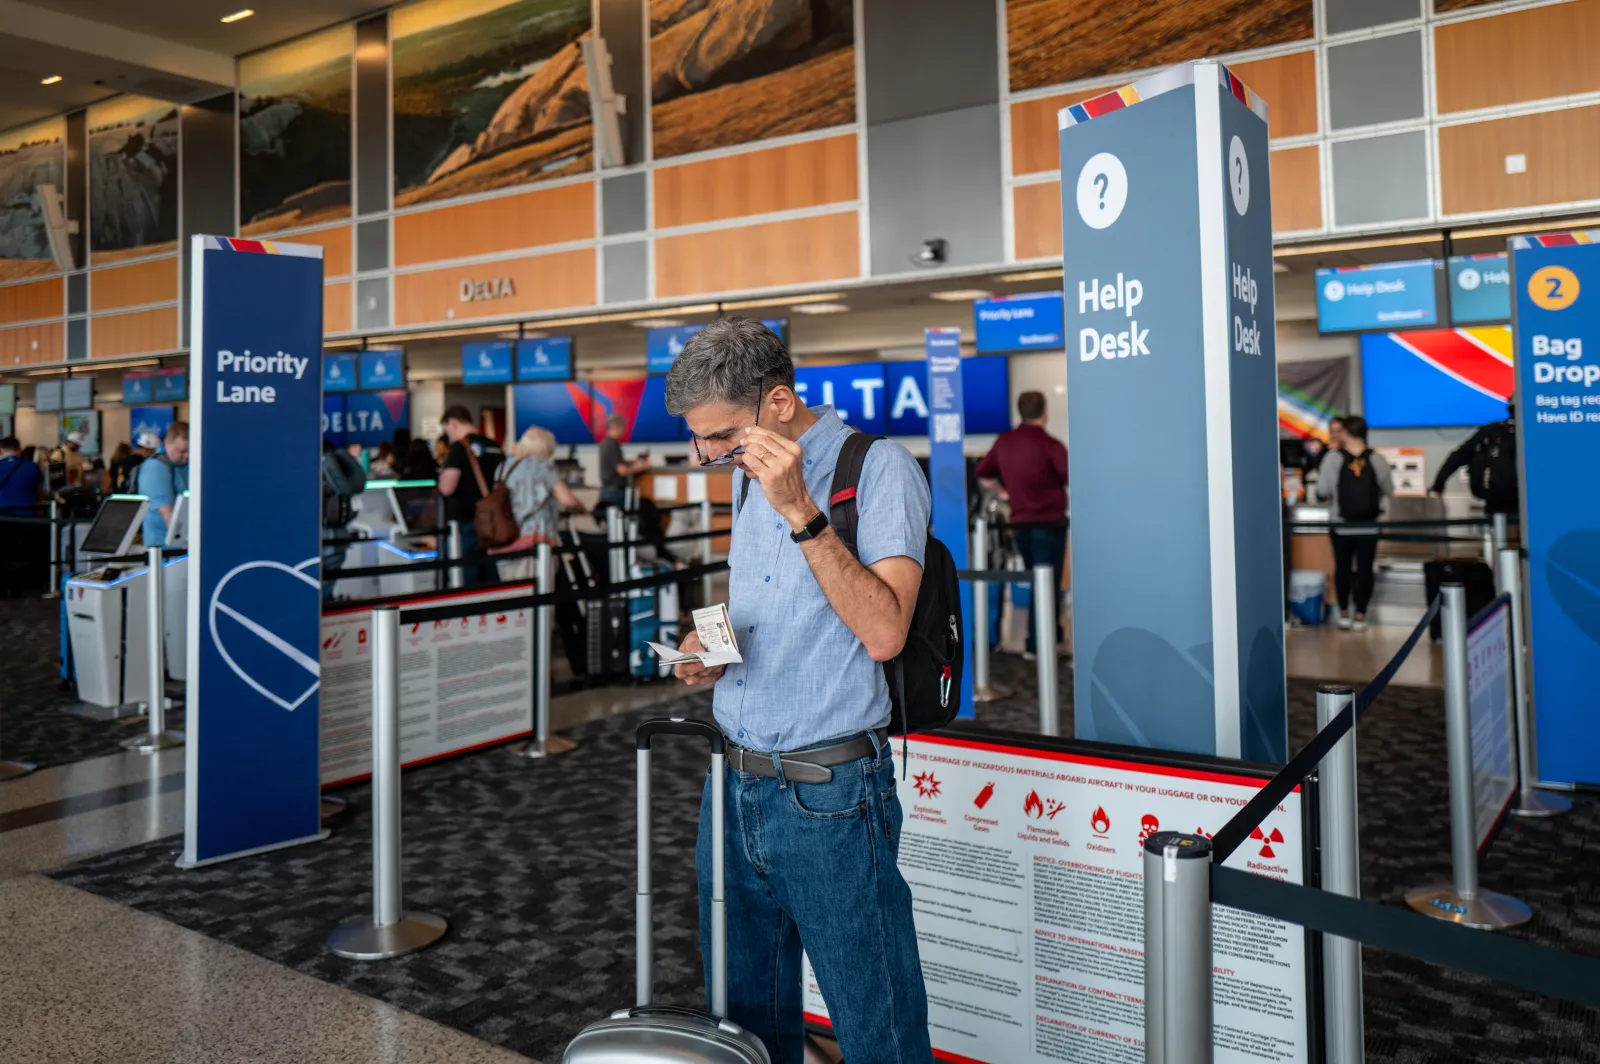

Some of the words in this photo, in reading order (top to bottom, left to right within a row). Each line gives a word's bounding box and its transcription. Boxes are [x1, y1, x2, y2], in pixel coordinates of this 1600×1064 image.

[460, 277, 514, 302] DELTA
[1078, 272, 1144, 317] Help
[1232, 262, 1258, 315] Help
[1545, 277, 1564, 299] 2
[1079, 320, 1150, 362] Desk
[1234, 315, 1261, 356] Desk
[1532, 334, 1582, 361] Bag
[217, 350, 309, 379] Priority
[1534, 361, 1600, 388] Drop
[217, 380, 276, 403] Lane
[1536, 394, 1559, 408] Bag
[1561, 394, 1580, 408] tag
[1537, 412, 1568, 424] Have
[1570, 411, 1584, 423] ID
[916, 752, 927, 760] THE
[929, 754, 961, 765] CARRIAGE
[962, 759, 971, 767] OF
[972, 761, 1015, 773] HAZARDOUS
[1016, 767, 1054, 779] MATERIALS
[1056, 773, 1086, 783] ABOARD
[1088, 777, 1122, 789] AIRCRAFT
[1125, 782, 1133, 790] IN
[1135, 784, 1156, 794] YOUR
[1158, 787, 1195, 799] LUGGAGE
[1196, 793, 1208, 801] OR
[1210, 795, 1221, 803] ON
[913, 804, 942, 816] Explosives
[920, 815, 947, 825] Fireworks
[963, 814, 999, 827] Compressed
[973, 824, 990, 833] Gases
[1026, 824, 1059, 837] Flammable
[1017, 832, 1038, 843] Liquids
[1039, 835, 1051, 844] and
[1051, 837, 1070, 847] Solids
[1086, 842, 1116, 854] Oxidizers
[1115, 870, 1143, 880] FLIGHTS
[1247, 860, 1288, 875] Radioactive
[1068, 935, 1118, 951] INTERNATIONAL
[1088, 986, 1122, 999] CONTRACT
